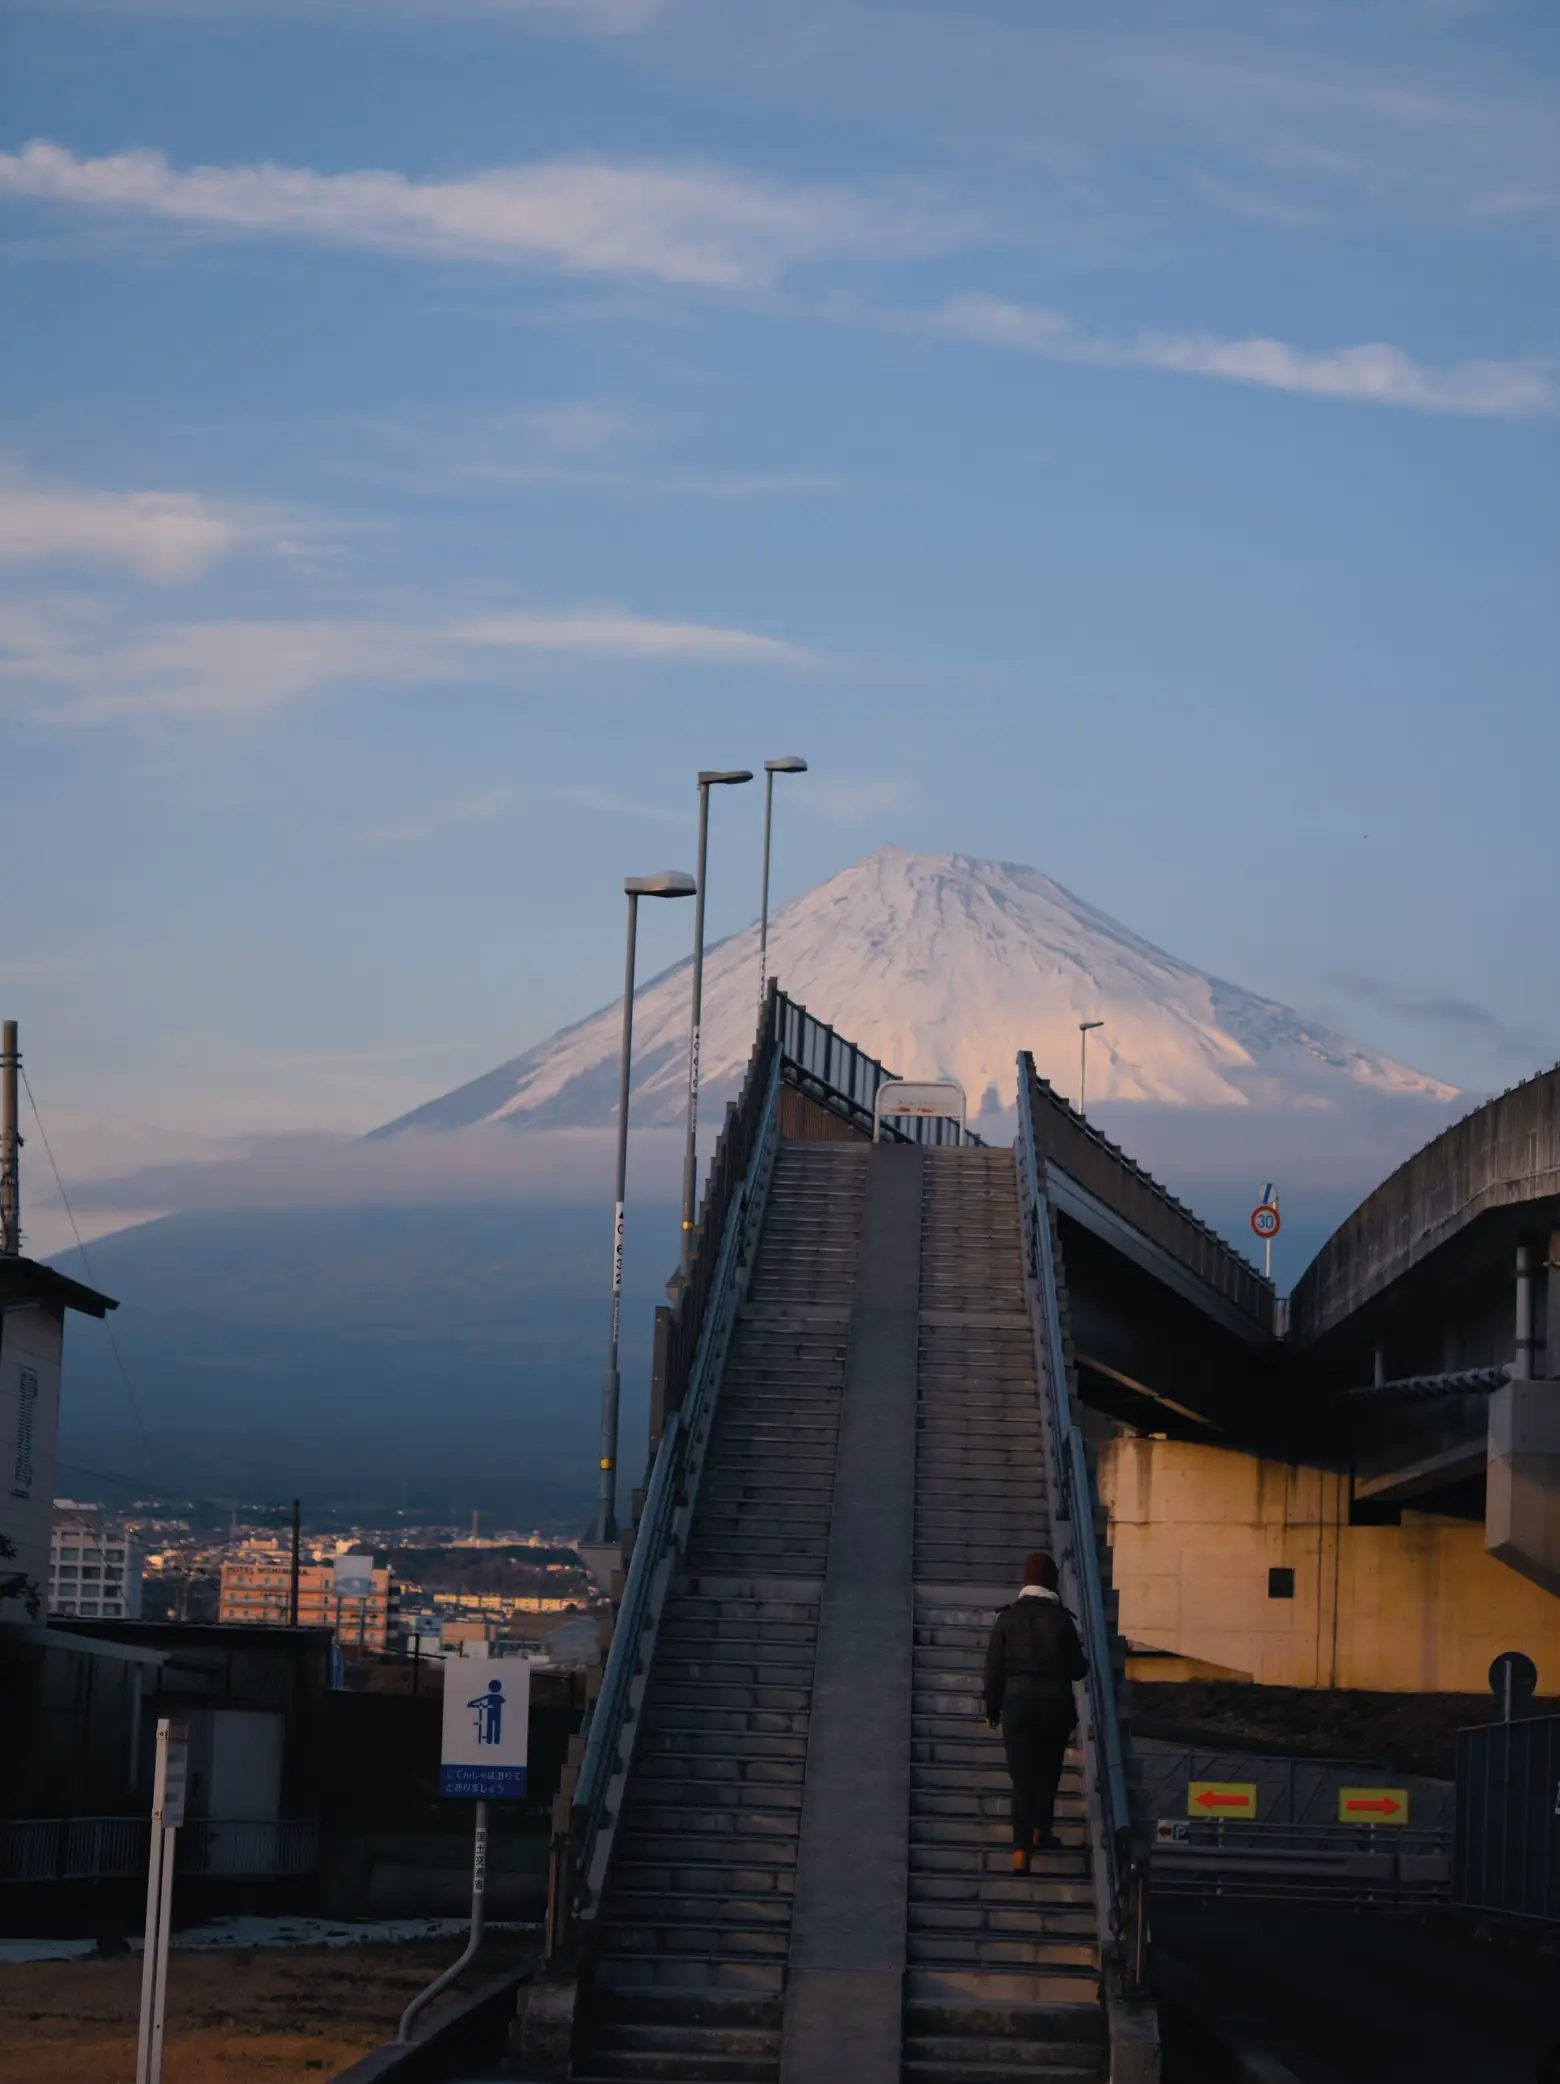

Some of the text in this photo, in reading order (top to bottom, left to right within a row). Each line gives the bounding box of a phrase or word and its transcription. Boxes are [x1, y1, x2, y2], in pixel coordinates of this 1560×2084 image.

[1257, 1214, 1274, 1230] 30
[1175, 1826, 1186, 1840] P
[475, 1831, 485, 1890] 国土交通省
